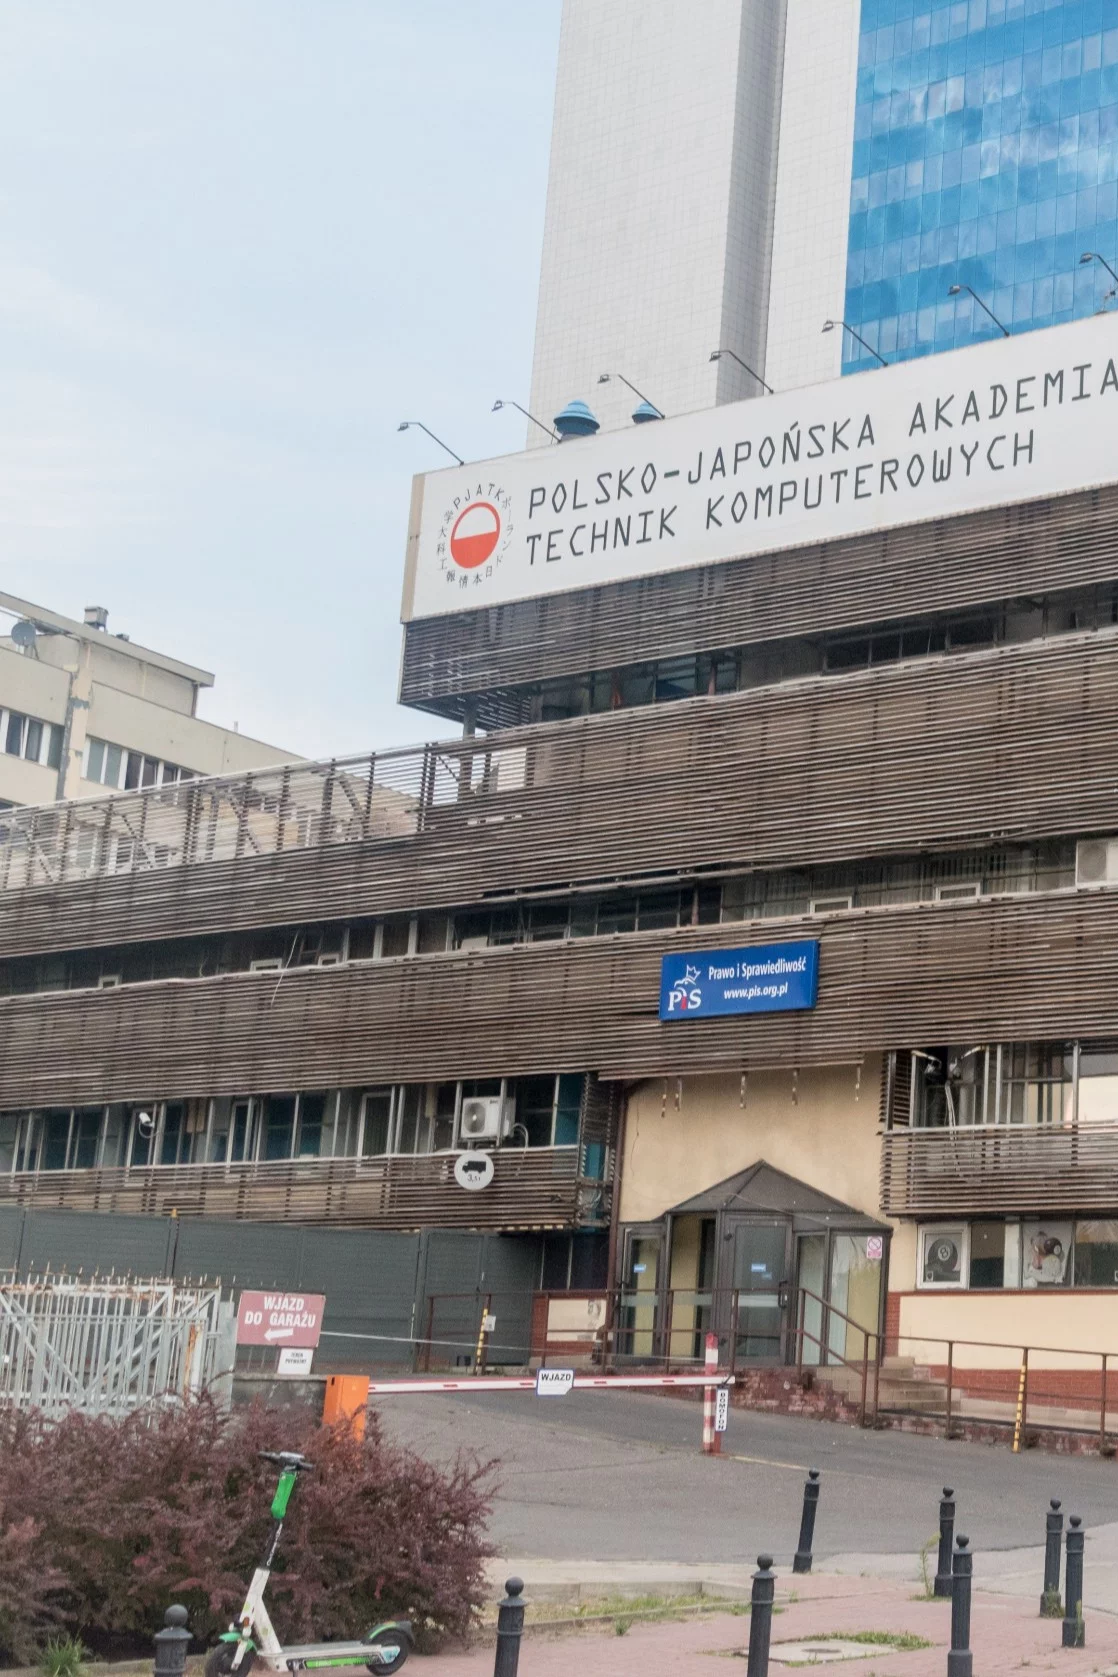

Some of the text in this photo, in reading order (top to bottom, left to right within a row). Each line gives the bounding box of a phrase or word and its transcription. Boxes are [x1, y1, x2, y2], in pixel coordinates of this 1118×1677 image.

[528, 413, 875, 521] POLSKO-JAPOŃSKA
[453, 482, 505, 509] PJATK
[526, 428, 1034, 565] TECHNIK KOMPUTEROWYCH
[708, 956, 807, 981] Prawo i Sprawiedliwość
[668, 987, 702, 1011] PiS
[724, 982, 788, 1000] www.pis.org.pl
[263, 1295, 305, 1311] WJAZD
[244, 1310, 316, 1328] DO GARAŻU
[541, 1372, 571, 1382] WJAZD
[718, 1392, 726, 1430] DOMOFON
